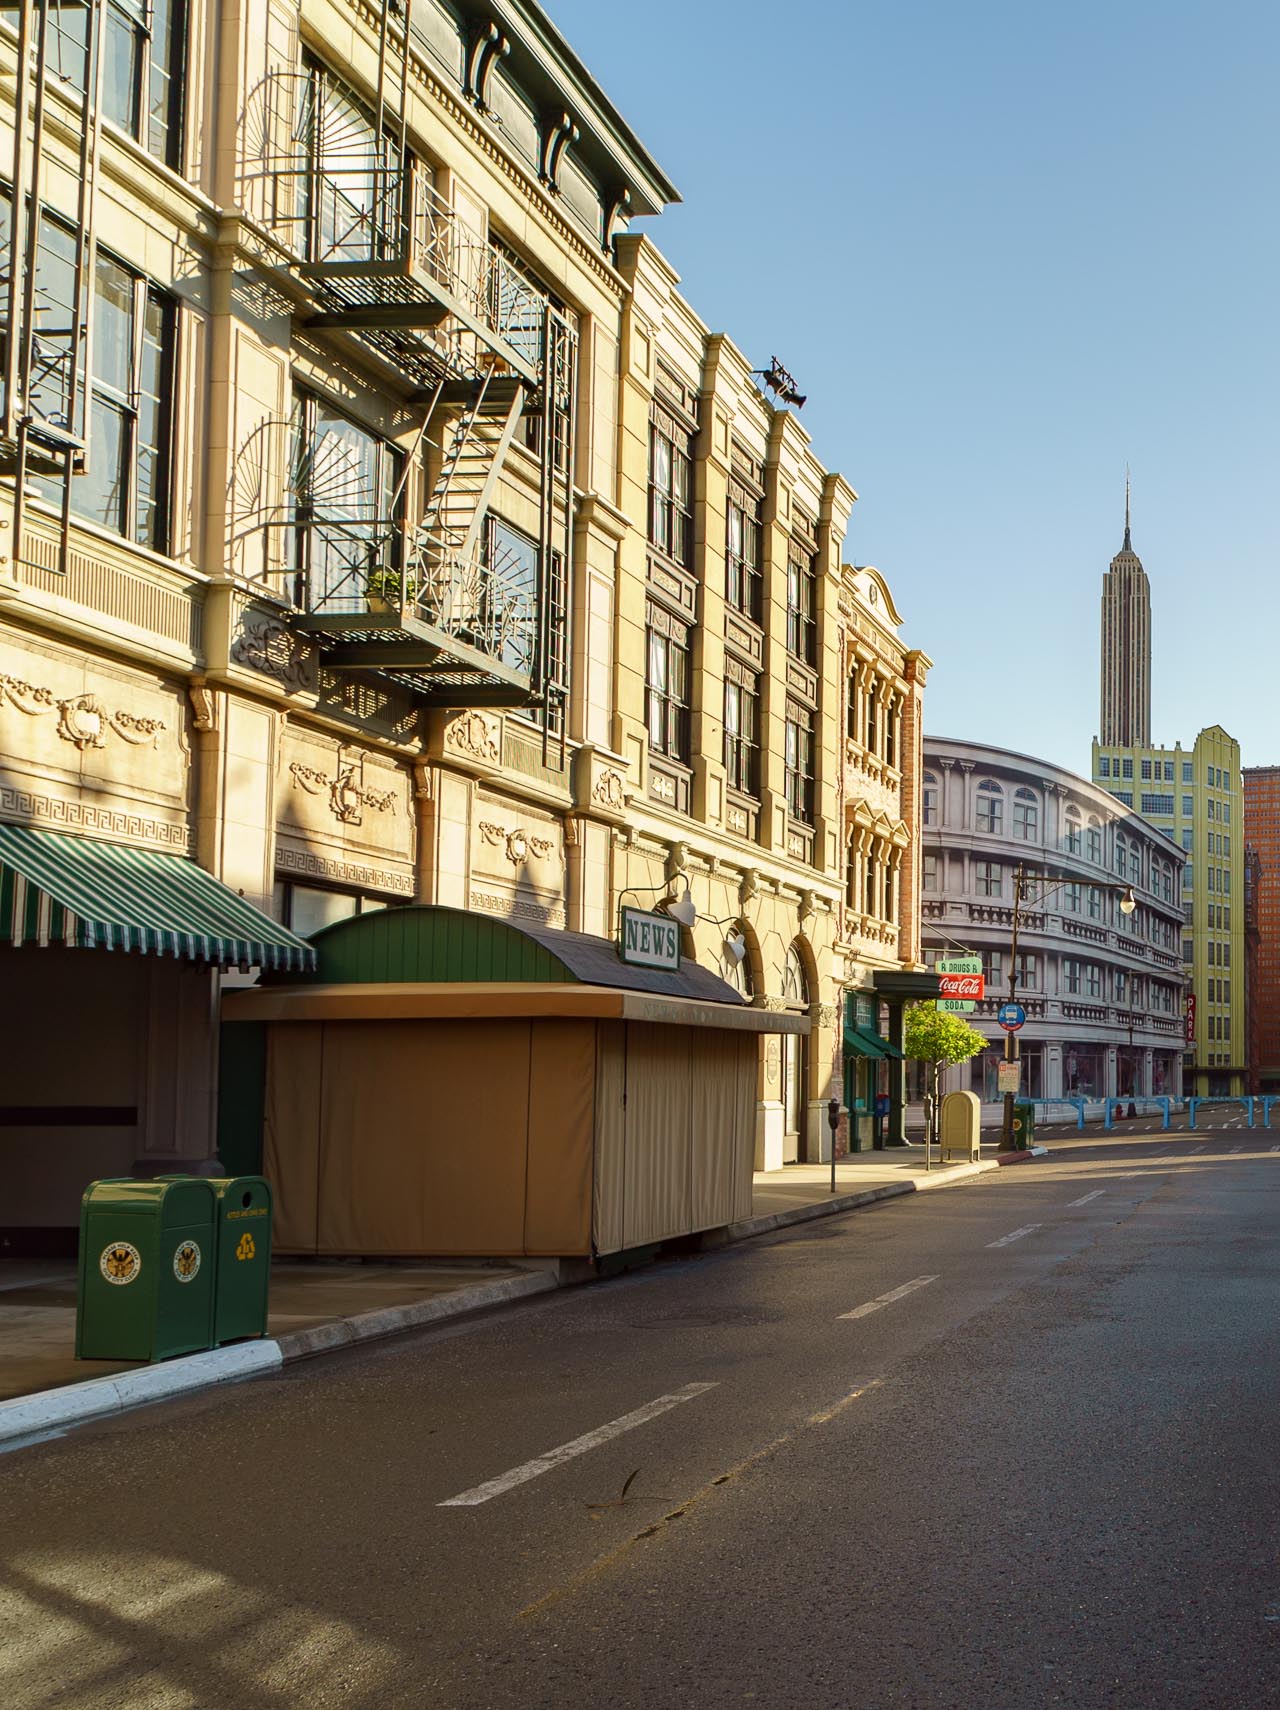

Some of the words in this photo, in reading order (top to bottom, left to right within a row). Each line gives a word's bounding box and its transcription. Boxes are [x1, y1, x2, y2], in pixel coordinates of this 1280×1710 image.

[626, 918, 676, 959] NEWS
[949, 963, 970, 973] DRUGS
[938, 977, 981, 994] Coca-Cola
[944, 1000, 964, 1010] SODA
